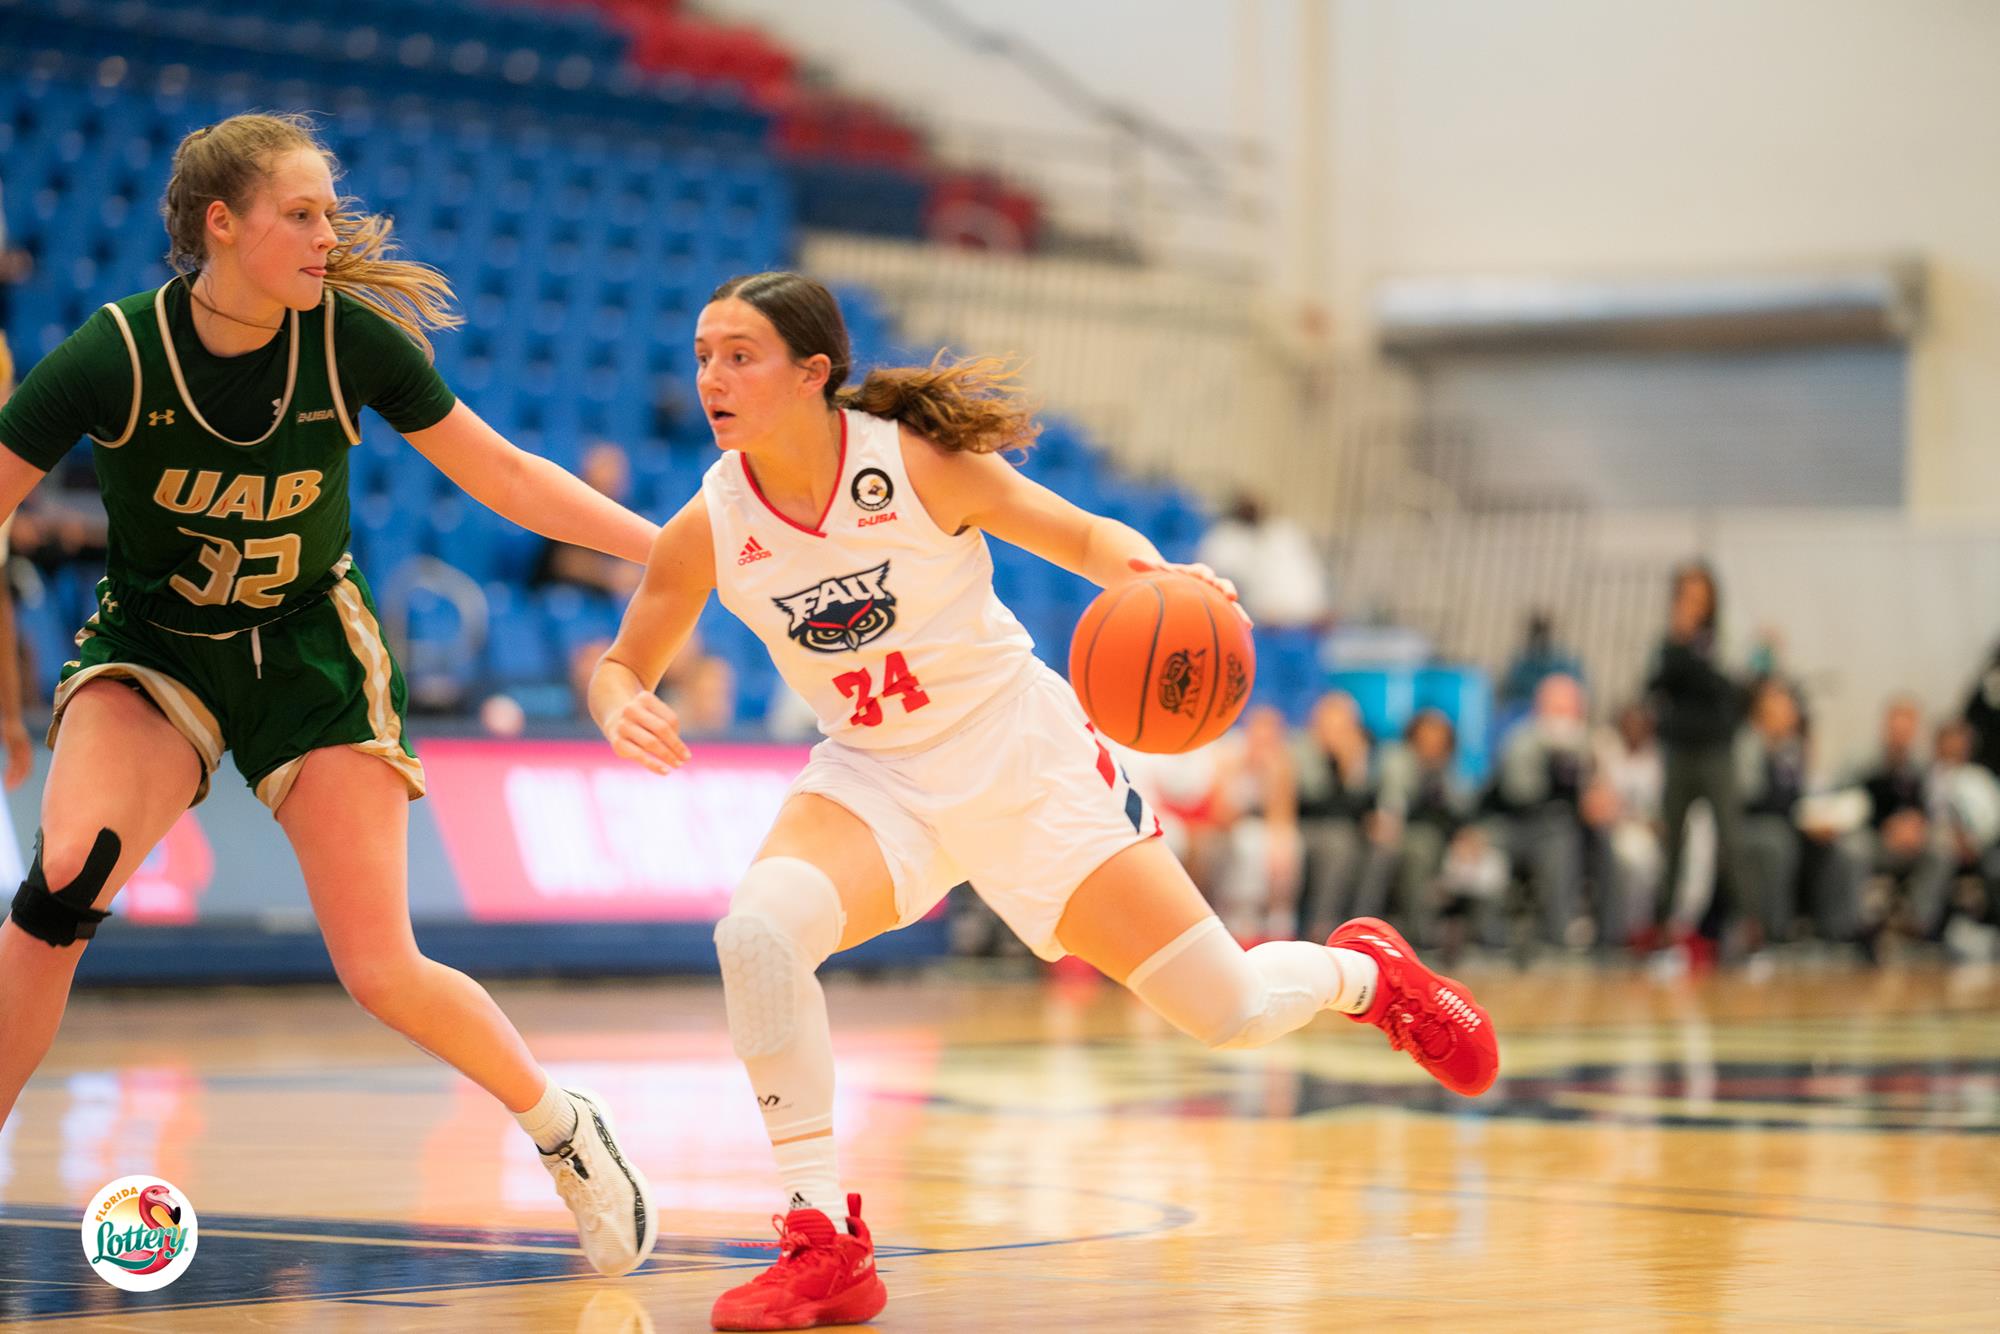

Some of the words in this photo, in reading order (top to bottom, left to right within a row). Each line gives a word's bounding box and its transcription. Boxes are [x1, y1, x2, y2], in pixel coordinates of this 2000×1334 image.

[153, 469, 323, 521] UAB
[169, 526, 302, 609] 32
[737, 550, 772, 566] adidas
[773, 560, 890, 635] FAU
[832, 651, 930, 727] 34
